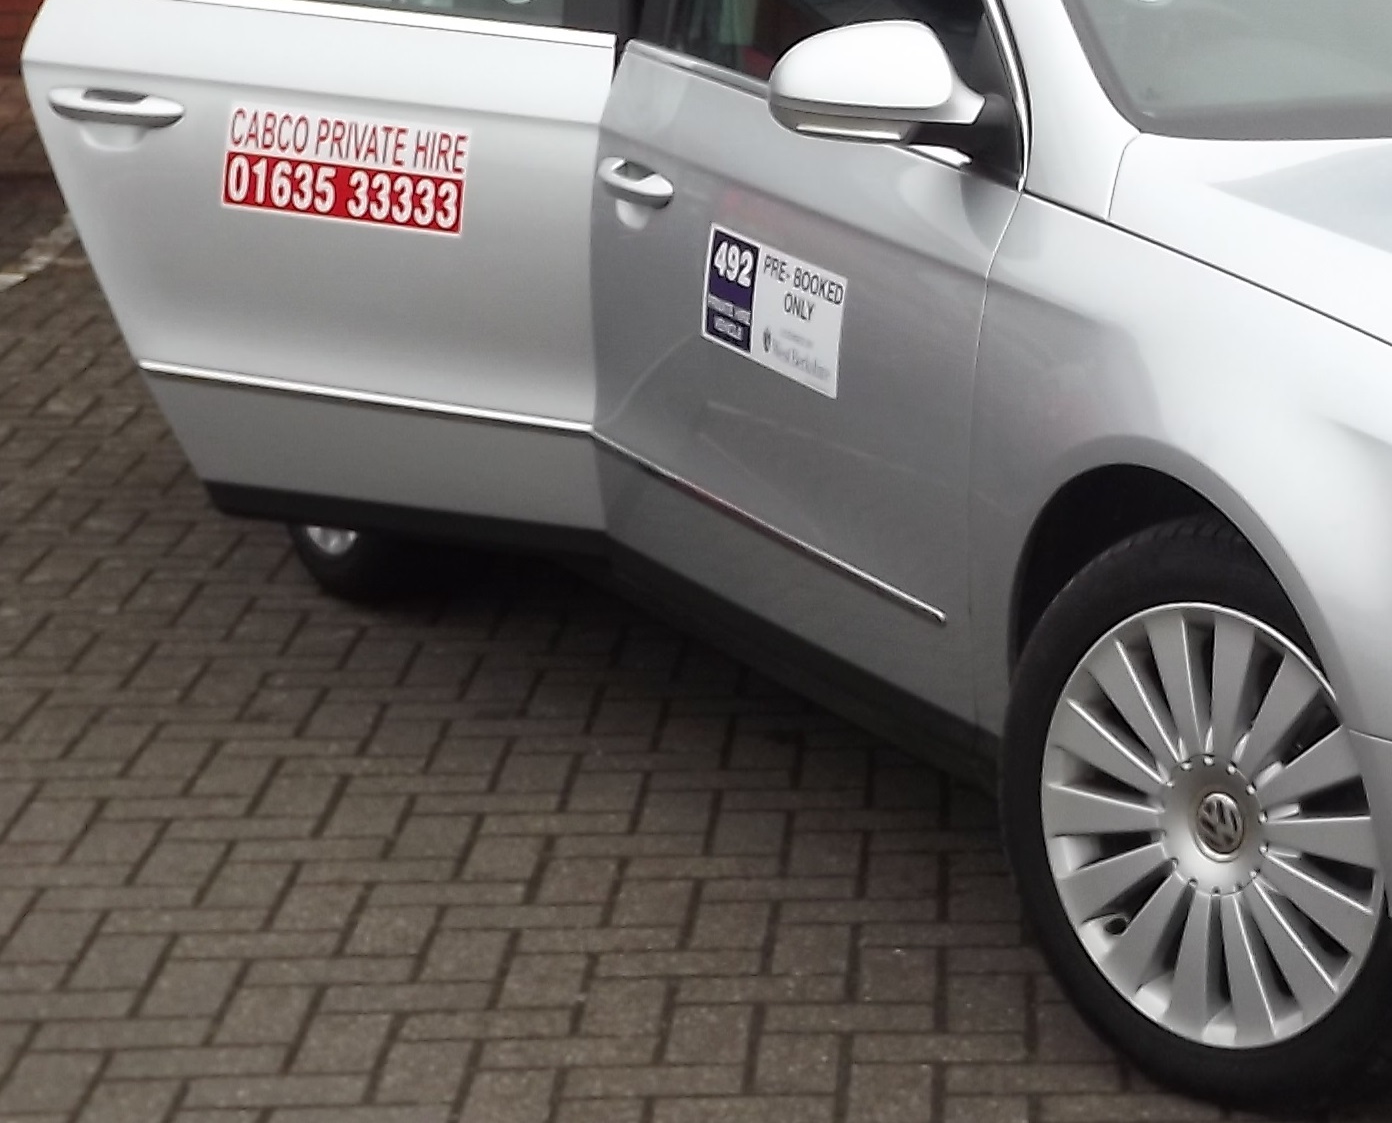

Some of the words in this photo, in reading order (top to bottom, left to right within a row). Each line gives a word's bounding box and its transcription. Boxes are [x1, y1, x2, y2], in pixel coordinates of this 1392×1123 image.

[229, 107, 310, 154] CABCO
[314, 118, 410, 167] PRIVATE
[413, 129, 469, 174] HIRE
[227, 155, 338, 214] 01635
[346, 170, 459, 229] 33333
[713, 240, 754, 288] 492
[793, 266, 845, 305] BOOKED
[784, 291, 816, 321] ONLY
